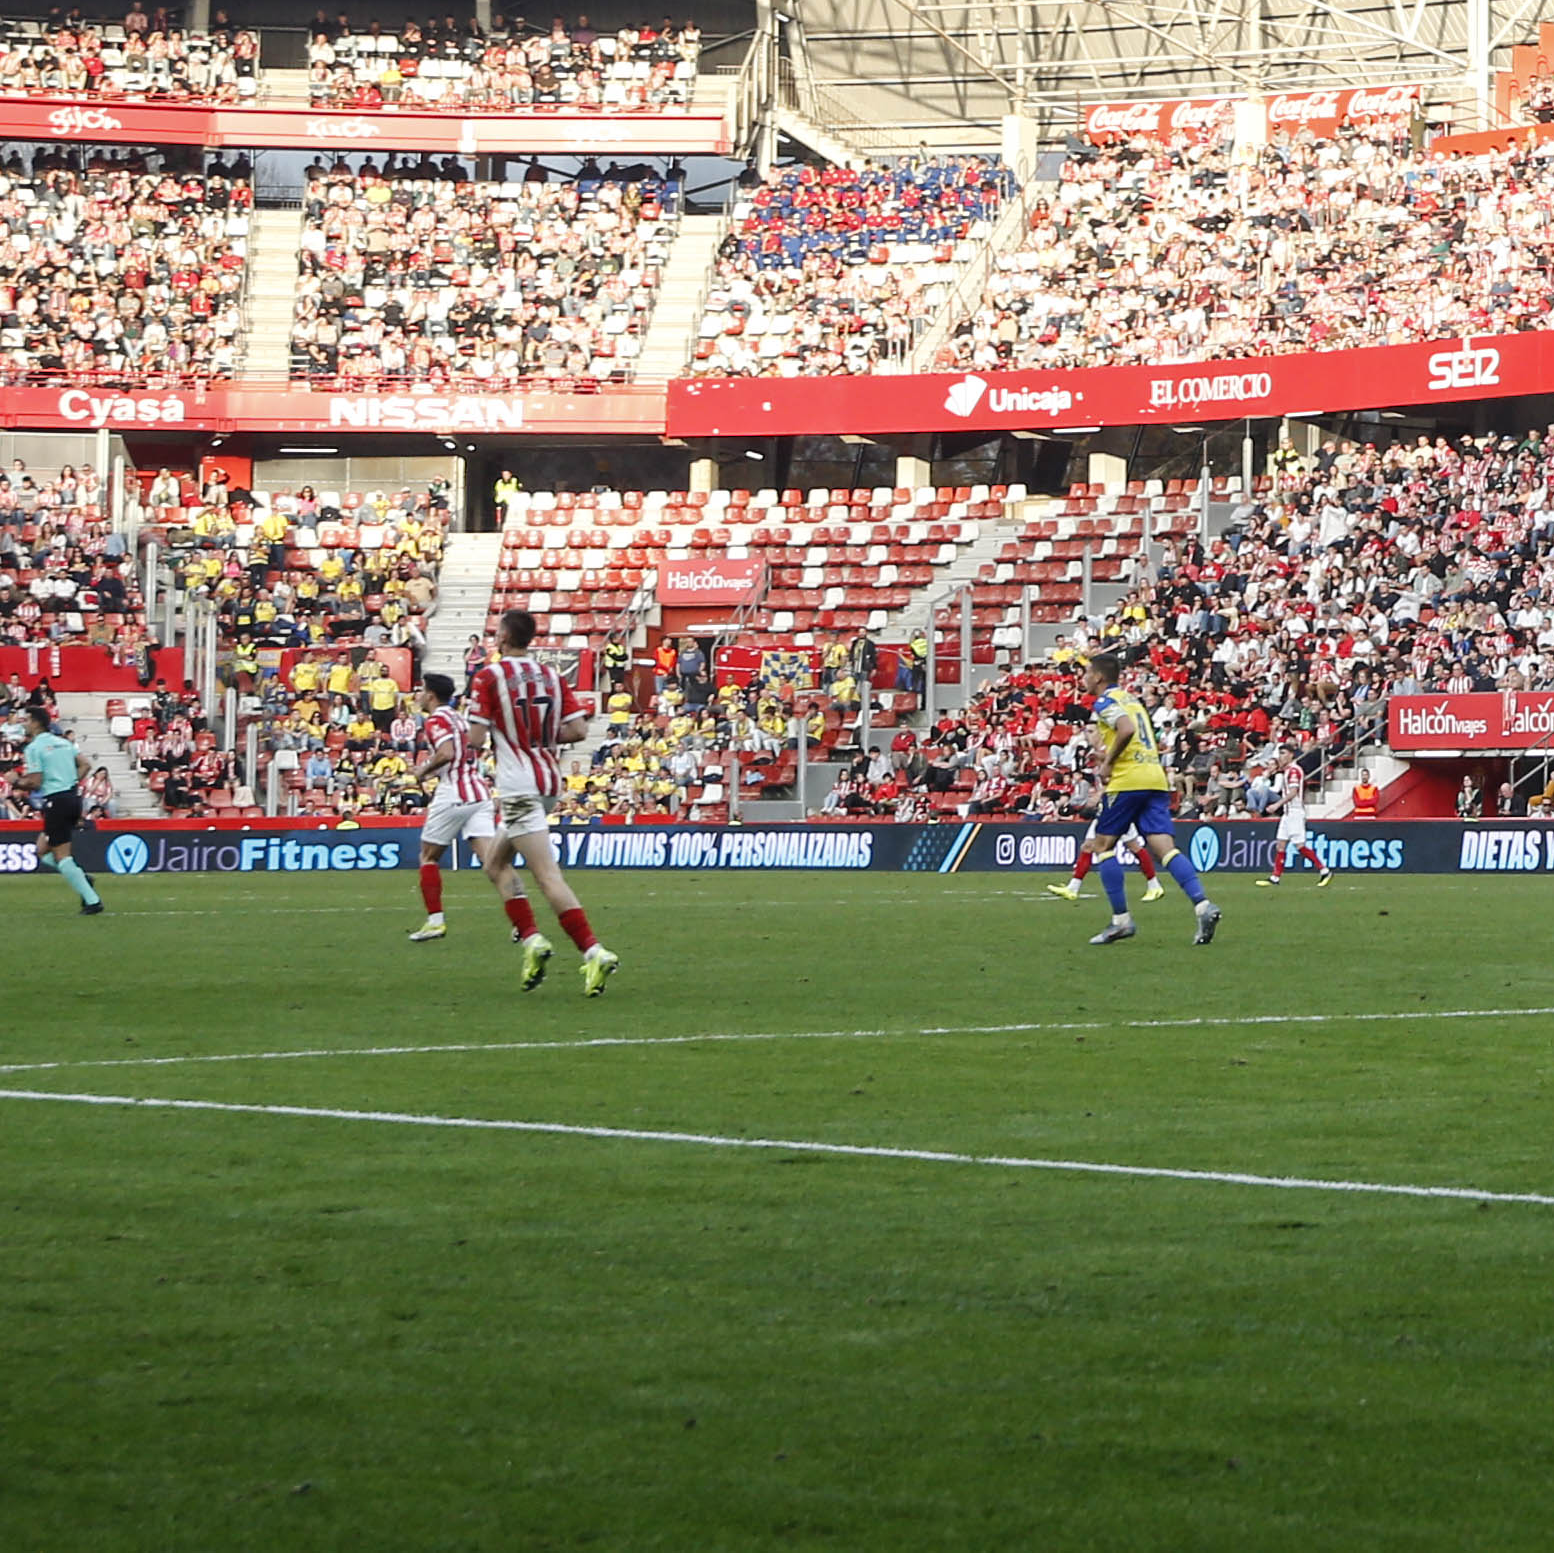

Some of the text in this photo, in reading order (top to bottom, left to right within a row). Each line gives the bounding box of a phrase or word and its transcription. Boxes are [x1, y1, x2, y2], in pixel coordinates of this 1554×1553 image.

[988, 384, 1072, 416] Unicaja
[1149, 372, 1272, 407] EL COMERCIO
[328, 396, 525, 429] NISSAN
[515, 695, 554, 749] 17
[1136, 711, 1153, 752] 4
[566, 832, 586, 867] Y
[585, 832, 668, 867] RUTINAS
[669, 832, 718, 867] 100%
[719, 832, 873, 868] PERSONALIZADAS
[1019, 835, 1076, 866] @JAIRO
[1459, 830, 1542, 870] DIETAS
